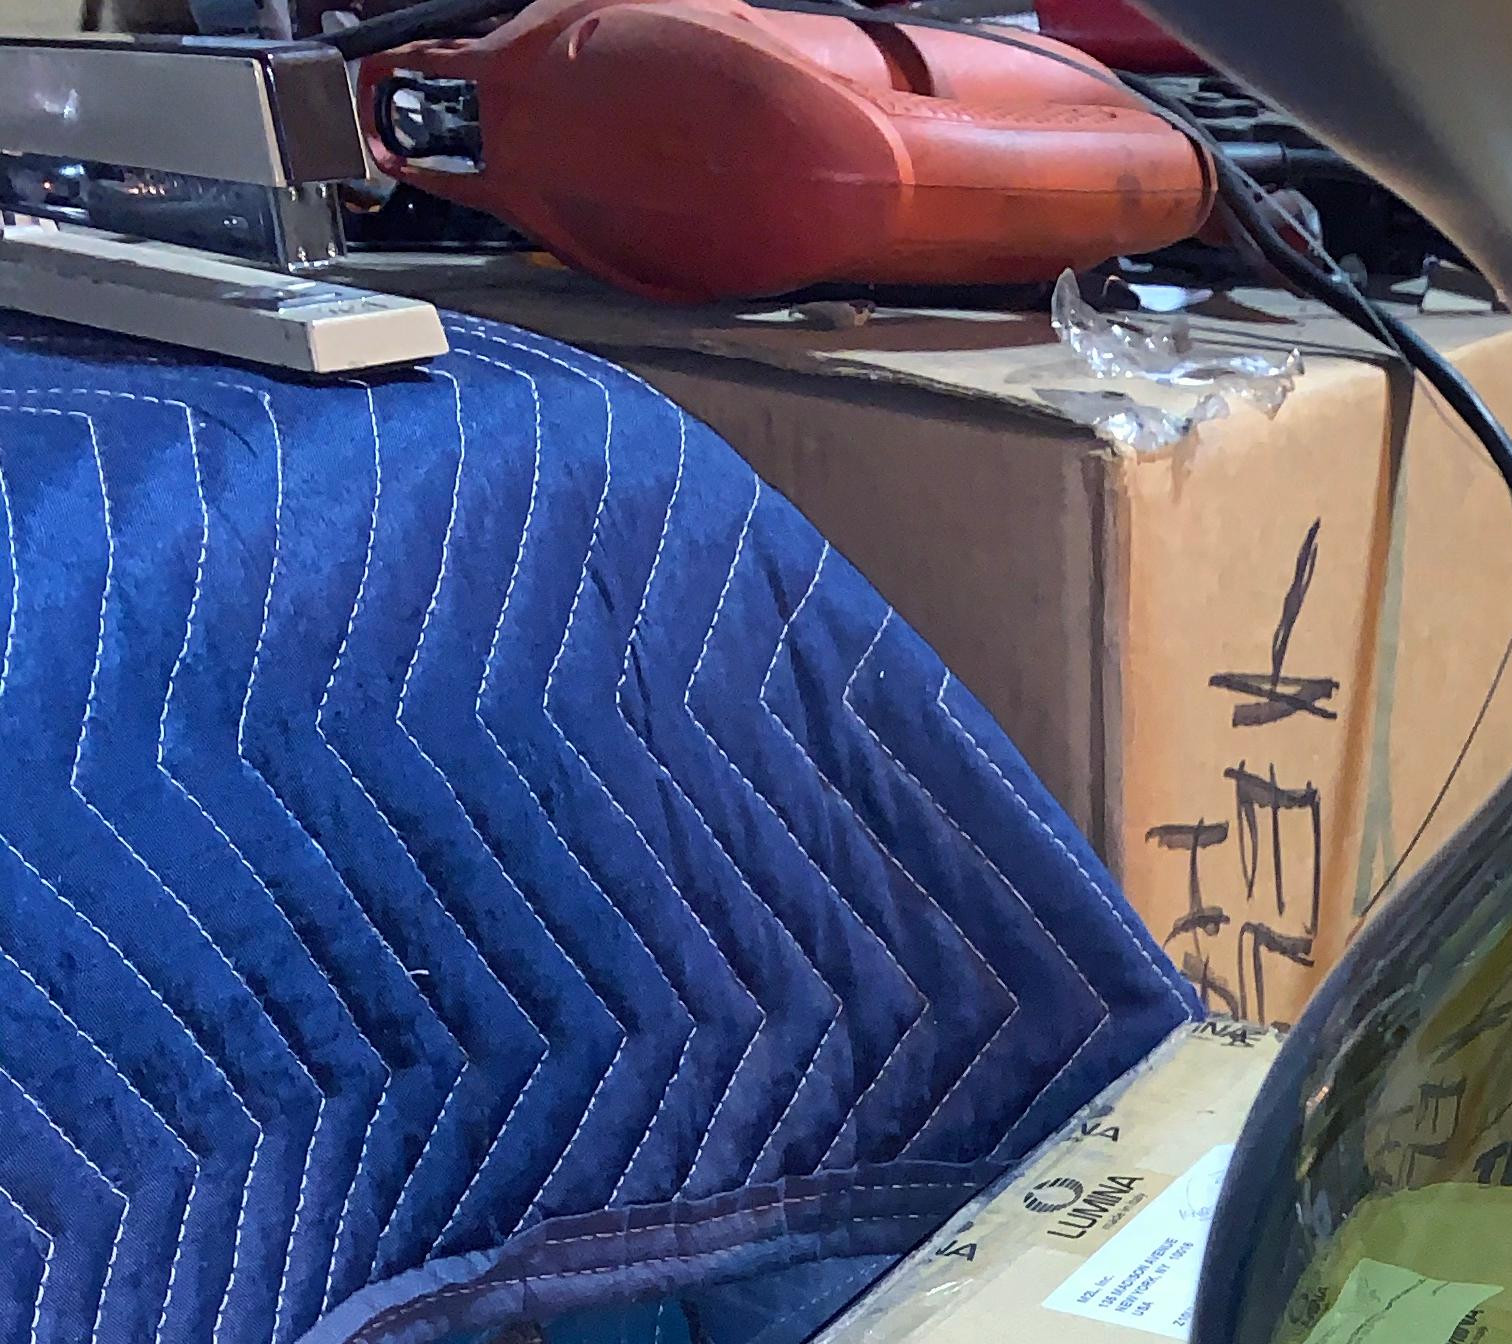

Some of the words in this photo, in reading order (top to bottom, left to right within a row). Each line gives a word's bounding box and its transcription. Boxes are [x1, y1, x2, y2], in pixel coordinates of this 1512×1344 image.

[1047, 1175, 1144, 1239] LUMINA
[1111, 1264, 1150, 1297] MADISON
[1144, 1236, 1179, 1266] AVENUE
[1114, 1291, 1139, 1313] NEW
[1154, 1262, 1171, 1275] NY
[1131, 1300, 1155, 1318] USA
